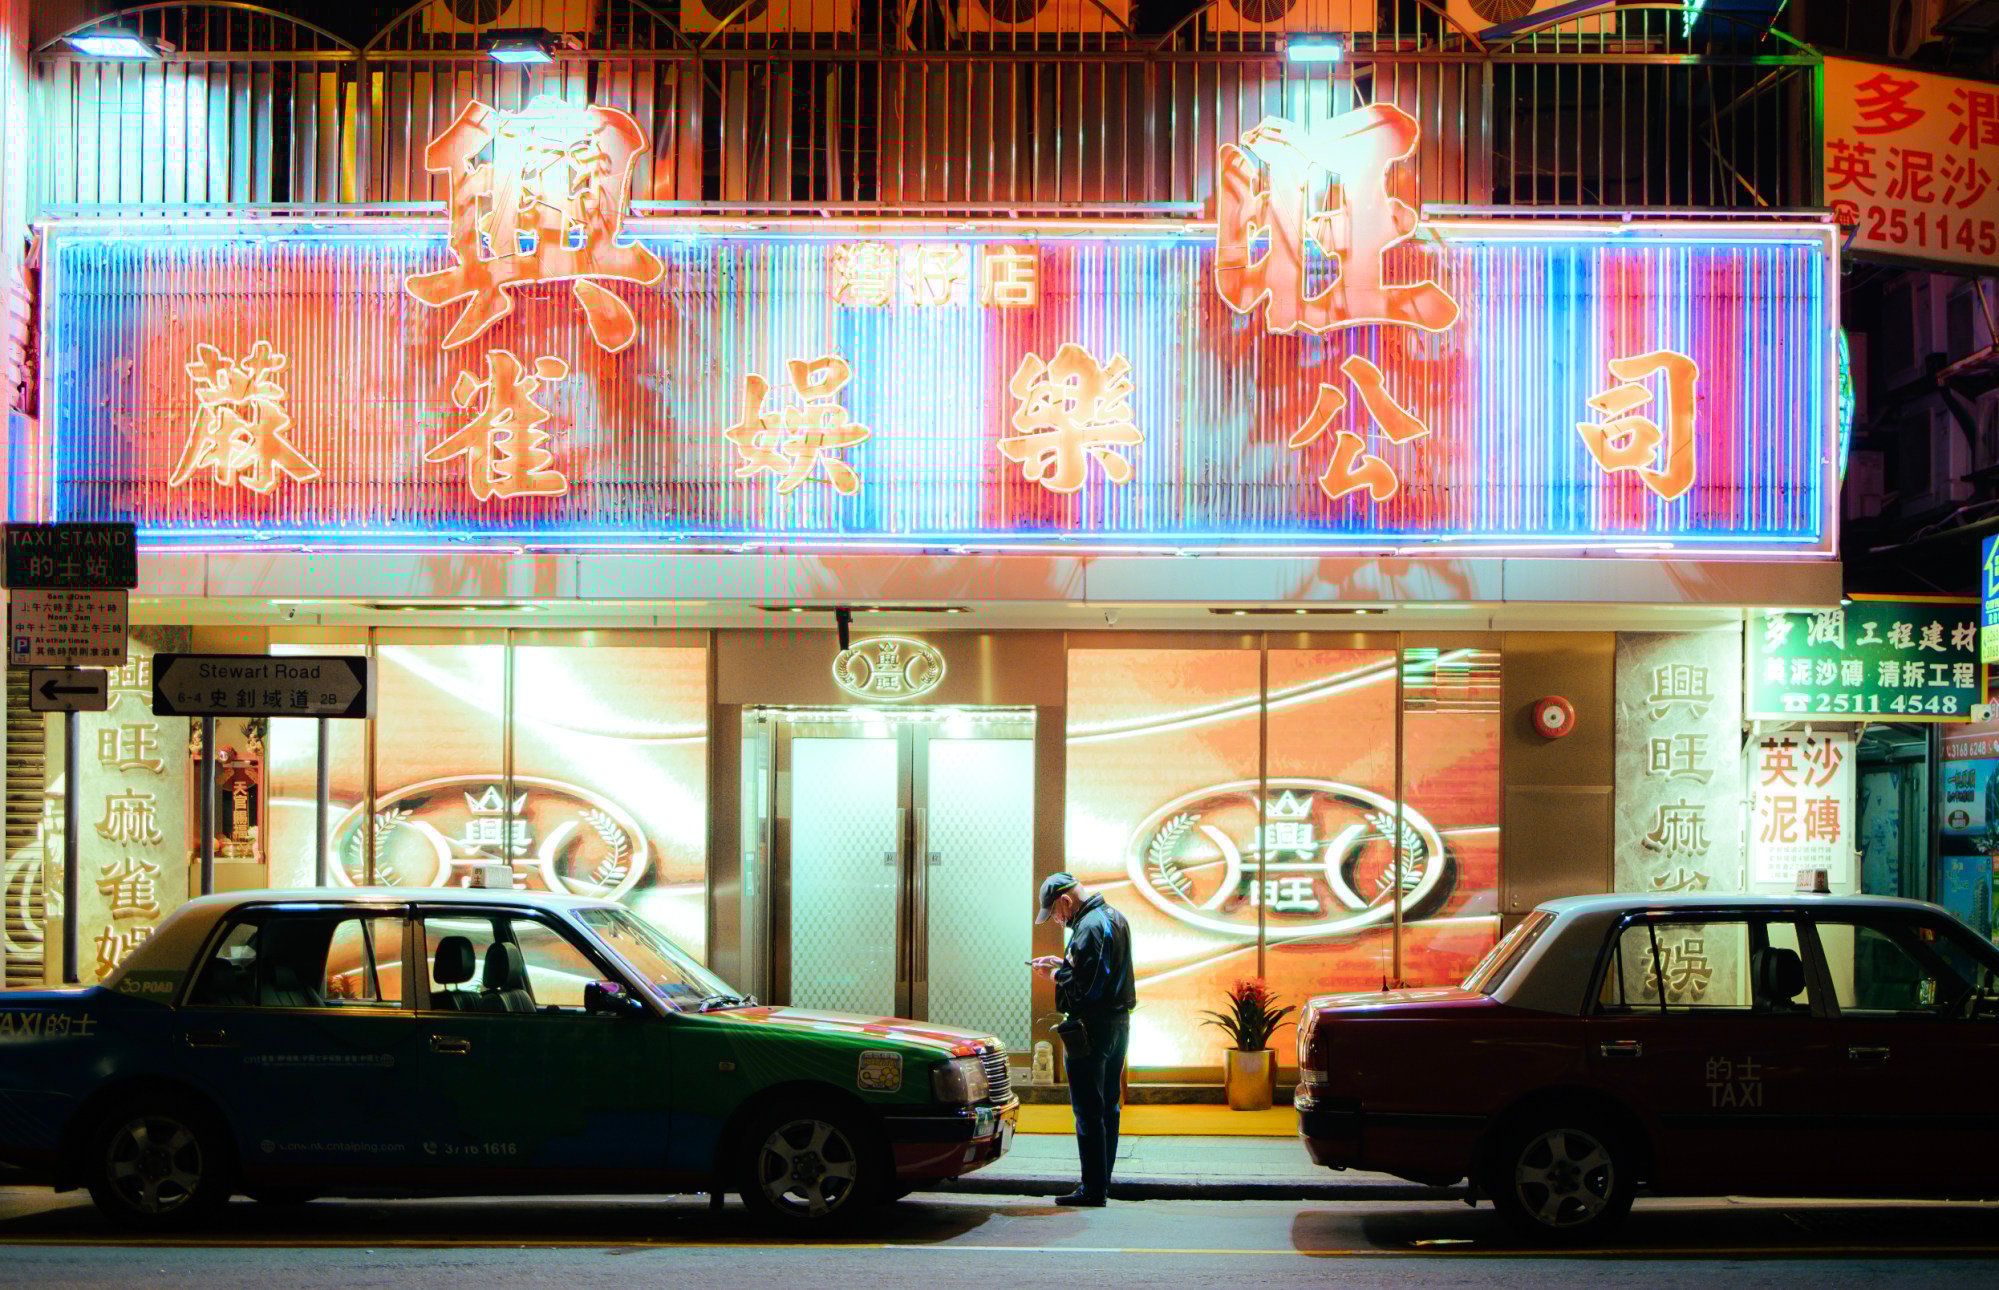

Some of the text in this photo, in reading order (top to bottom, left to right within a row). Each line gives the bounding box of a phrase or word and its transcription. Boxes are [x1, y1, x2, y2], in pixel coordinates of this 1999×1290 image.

[1826, 138, 1999, 210] 英泥沙
[1867, 205, 1997, 256] 251145
[9, 531, 127, 546] TAXI STAND
[30, 555, 107, 578] 的士站
[1856, 620, 1977, 653] 工程建材
[199, 663, 321, 679] Stewart Road
[1878, 660, 1975, 688] 清拆工程
[209, 688, 309, 709] 史釗域道
[320, 693, 337, 705] 2B
[1816, 694, 1957, 713] 2511 4548
[44, 1012, 98, 1037] 的士
[1705, 1056, 1762, 1081] 的士
[1704, 1082, 1763, 1108] TAXI
[483, 1142, 517, 1154] 1616
